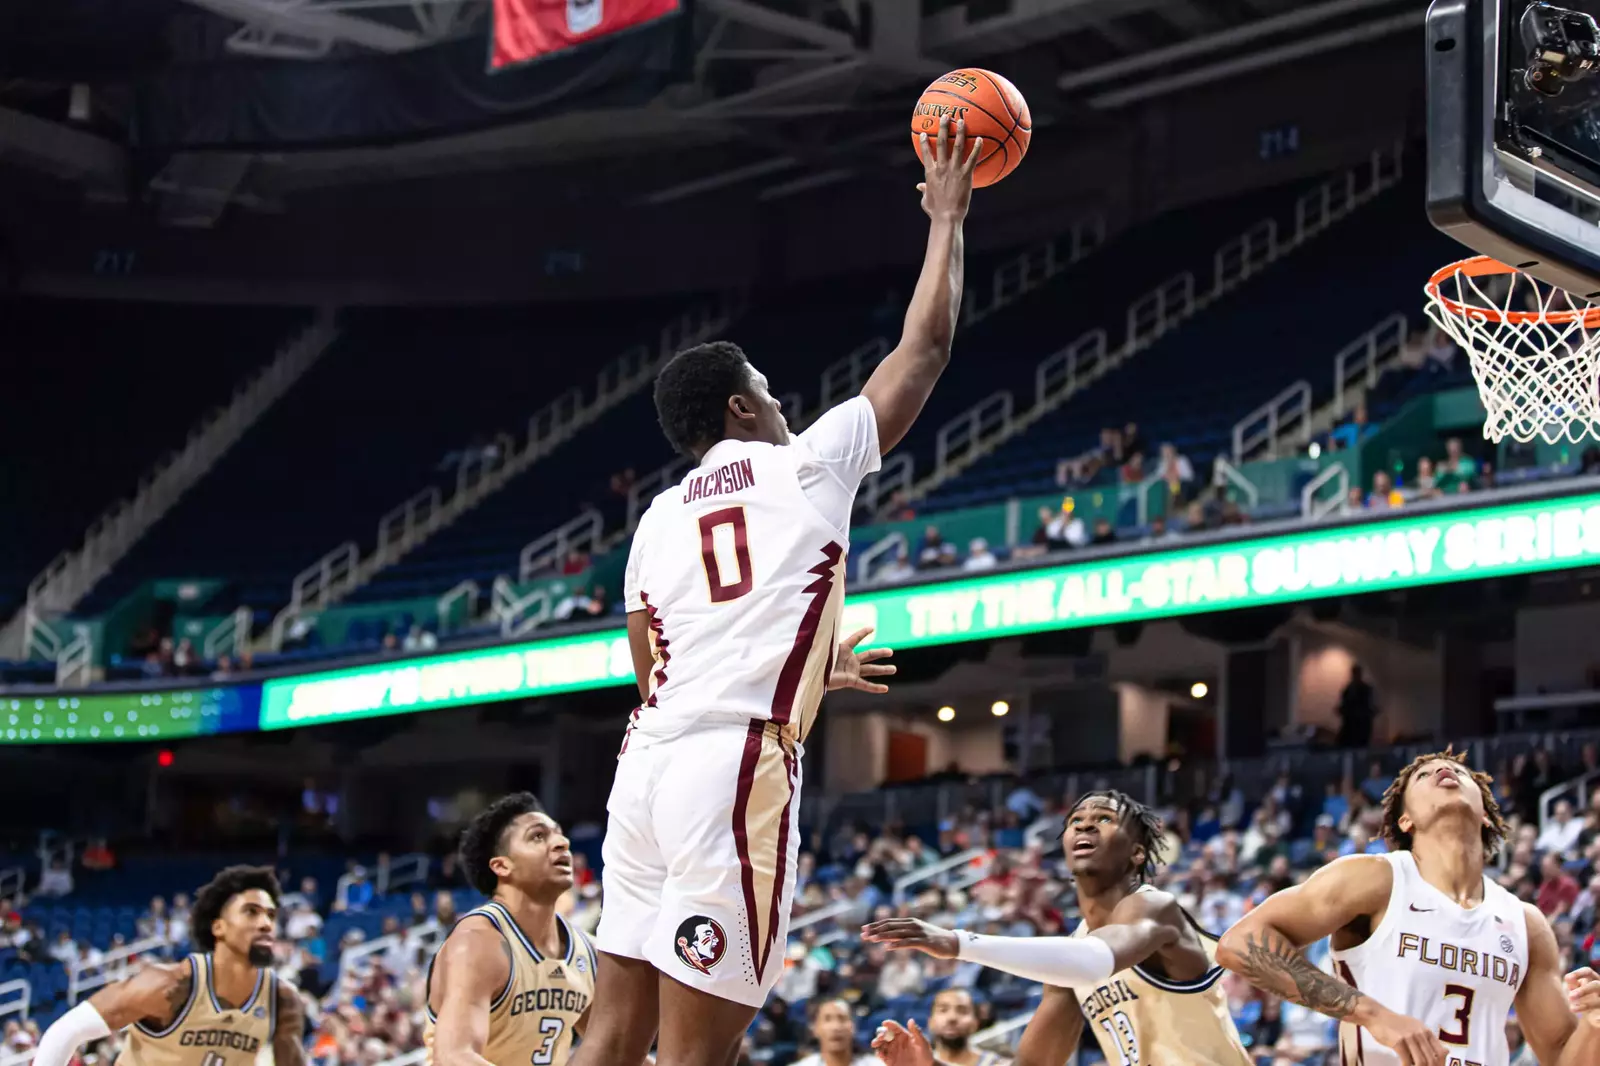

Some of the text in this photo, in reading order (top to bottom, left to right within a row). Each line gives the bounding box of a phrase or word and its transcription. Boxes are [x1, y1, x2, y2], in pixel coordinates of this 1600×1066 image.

[683, 458, 755, 504] JACKSON
[697, 505, 754, 605] 0
[906, 592, 980, 637] TRY
[1056, 554, 1249, 620] ALL-STAR
[1252, 526, 1441, 596] SUBWAY
[1397, 932, 1520, 990] FLORIDA
[531, 1016, 565, 1065] 3
[1438, 983, 1475, 1047] 3
